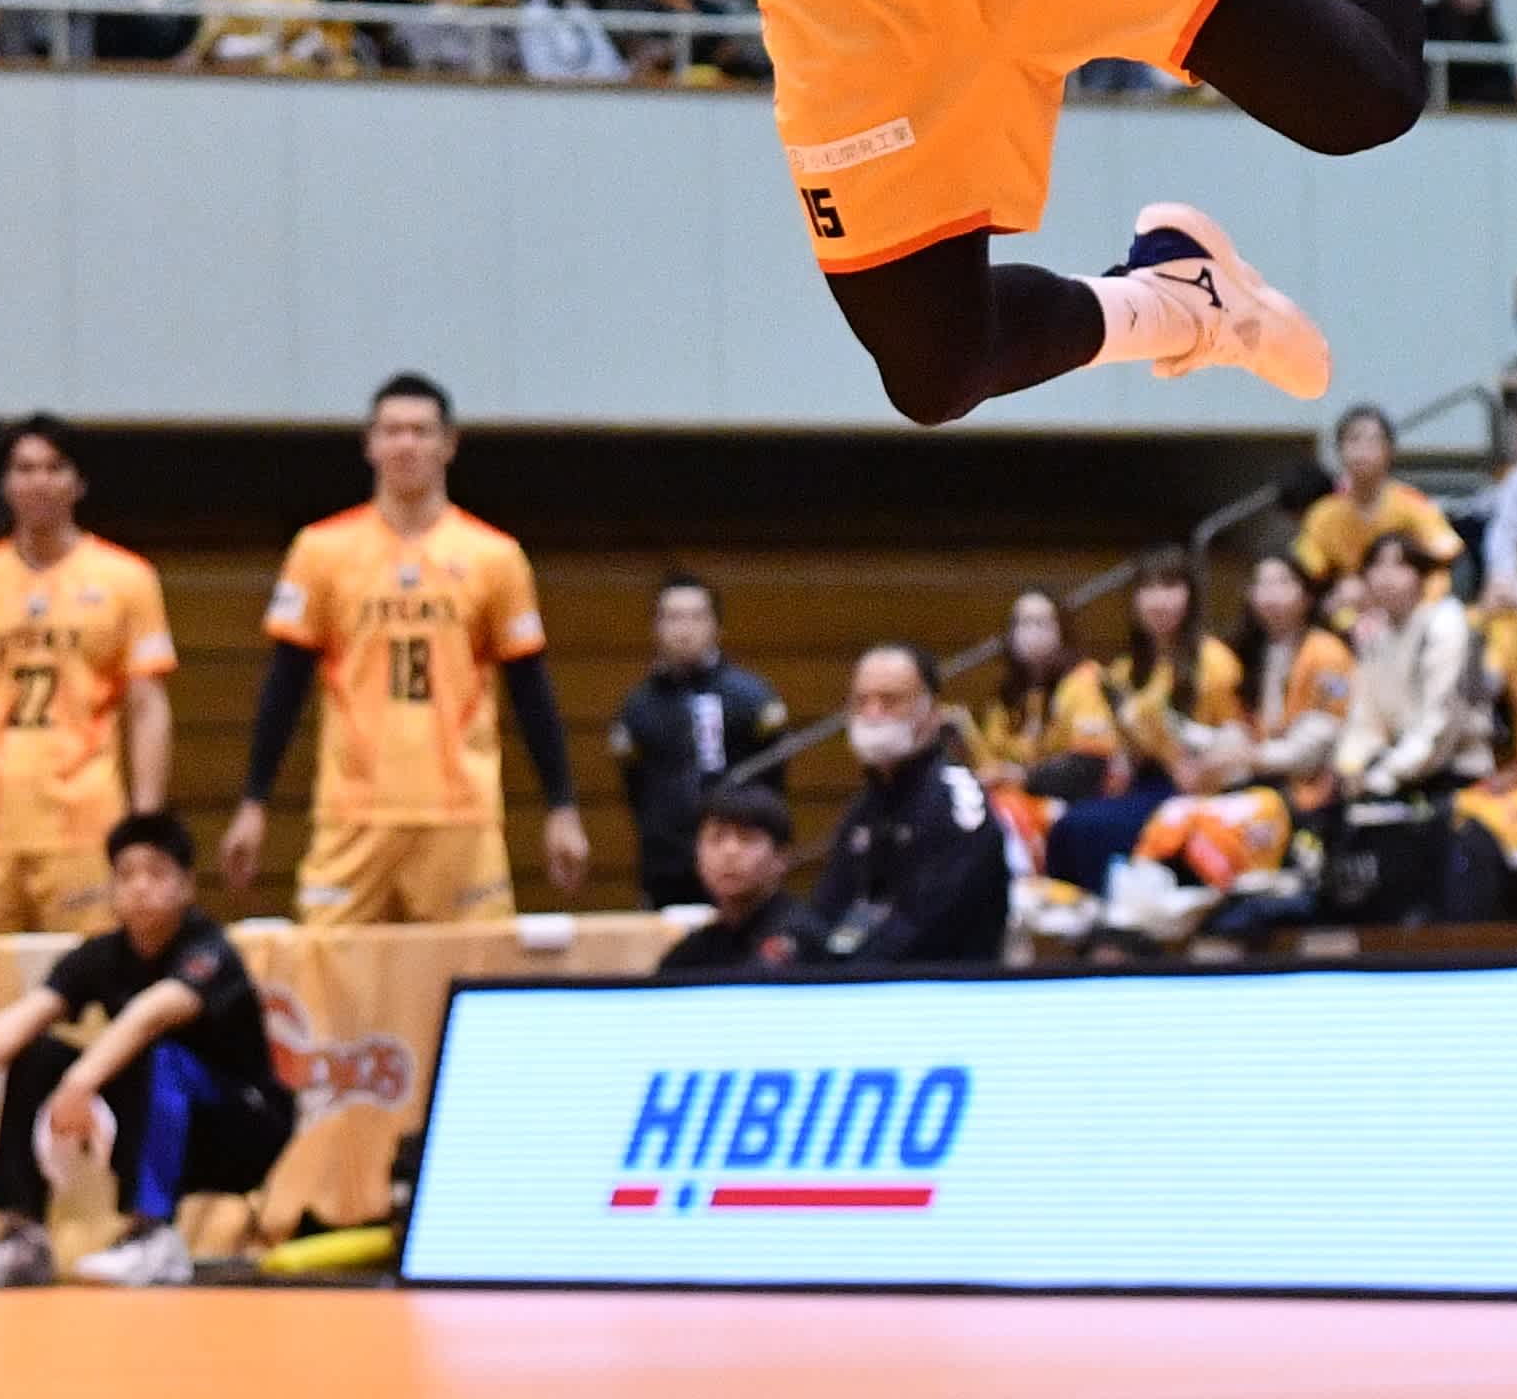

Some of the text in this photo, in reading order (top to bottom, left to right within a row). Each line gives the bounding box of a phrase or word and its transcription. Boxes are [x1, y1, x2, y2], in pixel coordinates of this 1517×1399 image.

[800, 187, 846, 238] 15
[387, 634, 432, 702] 18
[620, 1066, 972, 1168] HIBINO
